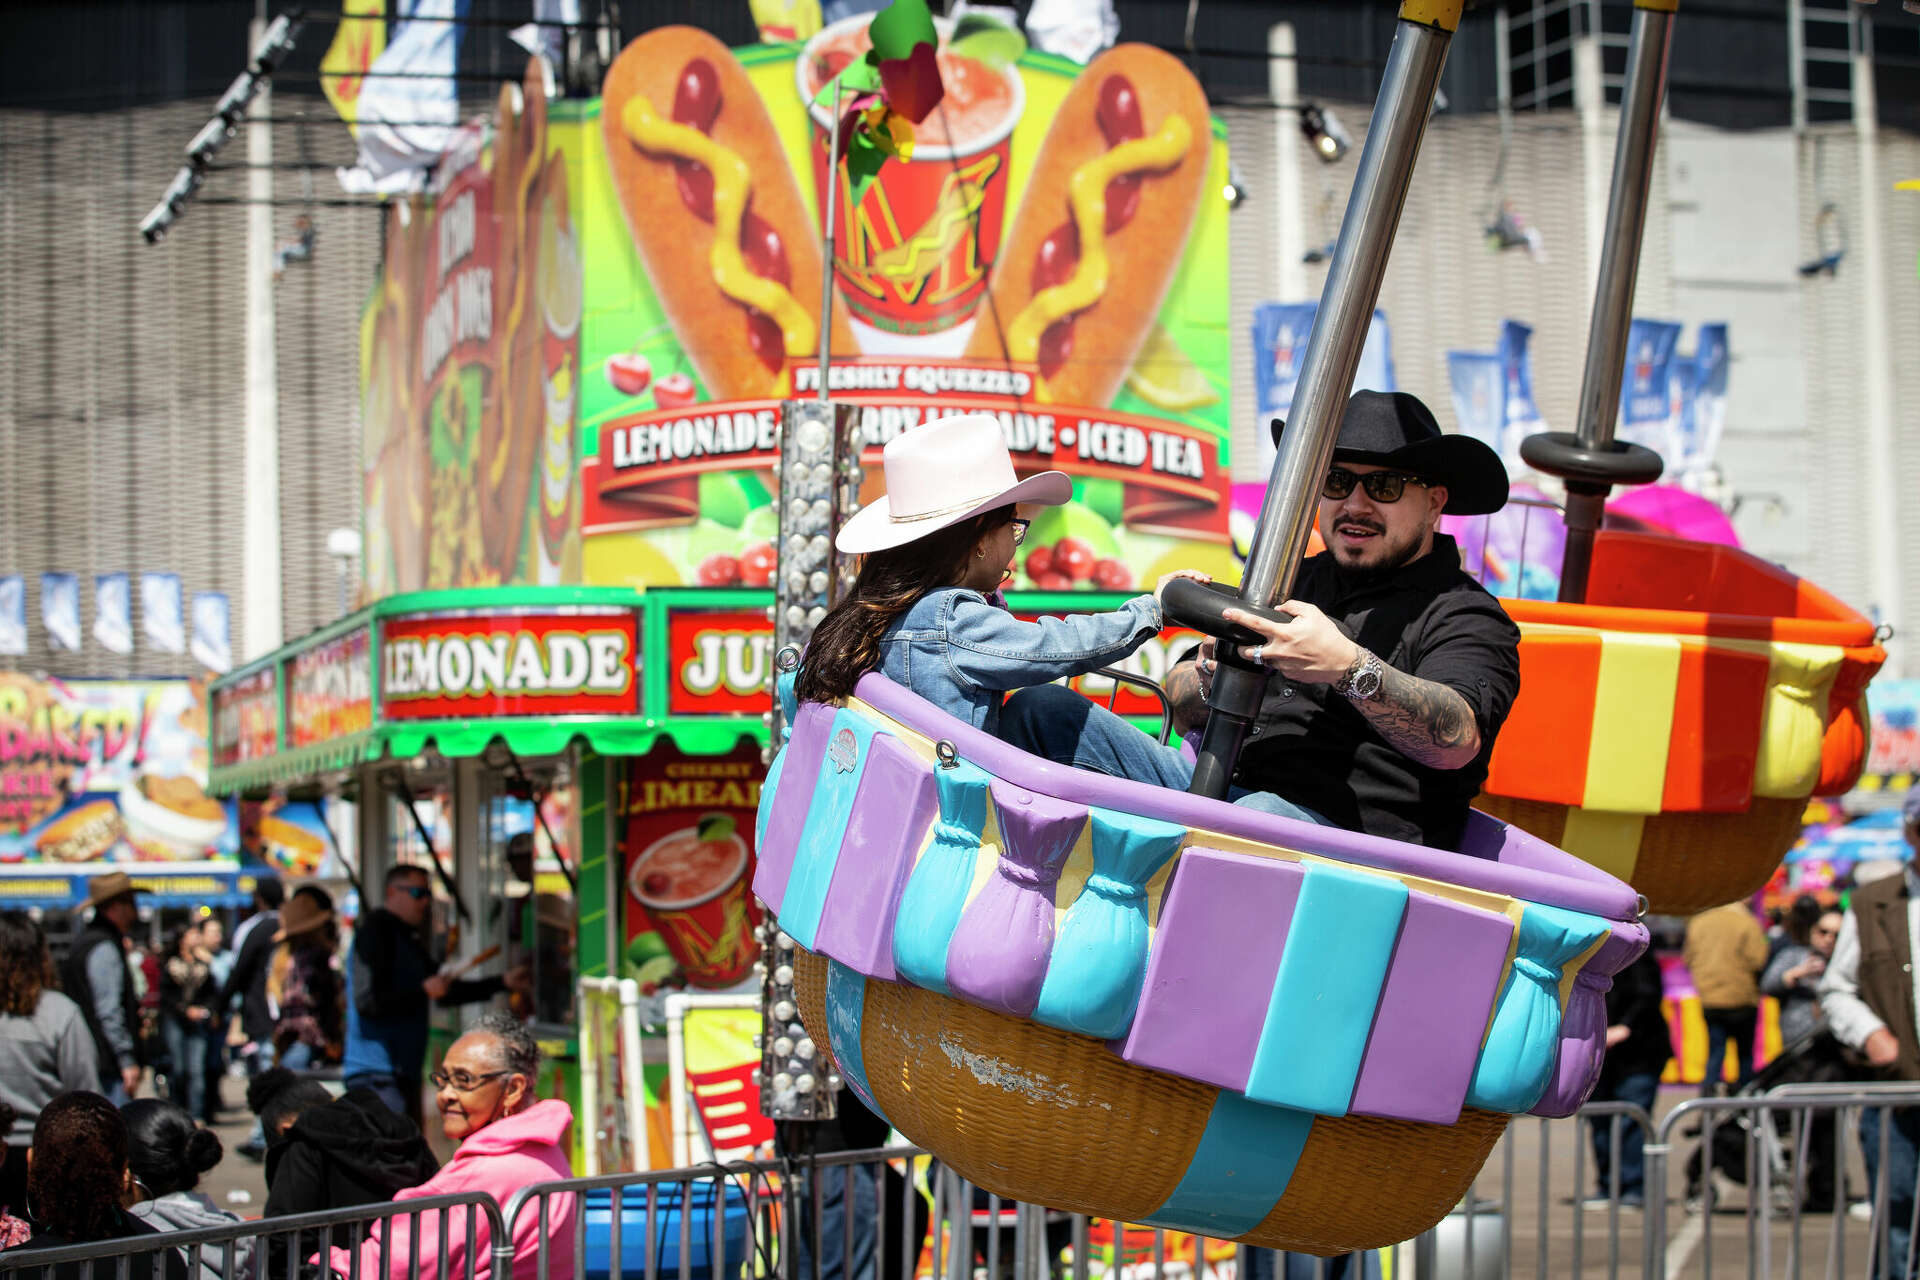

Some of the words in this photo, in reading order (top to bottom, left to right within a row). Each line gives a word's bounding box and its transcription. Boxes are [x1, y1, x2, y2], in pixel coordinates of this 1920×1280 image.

[903, 366, 1031, 397] SQUEEZED
[611, 410, 775, 469] LEMONADE
[1077, 419, 1148, 467] ICED
[1149, 431, 1204, 479] TEA
[383, 634, 627, 694] LEMONADE
[665, 762, 754, 778] CHERRY
